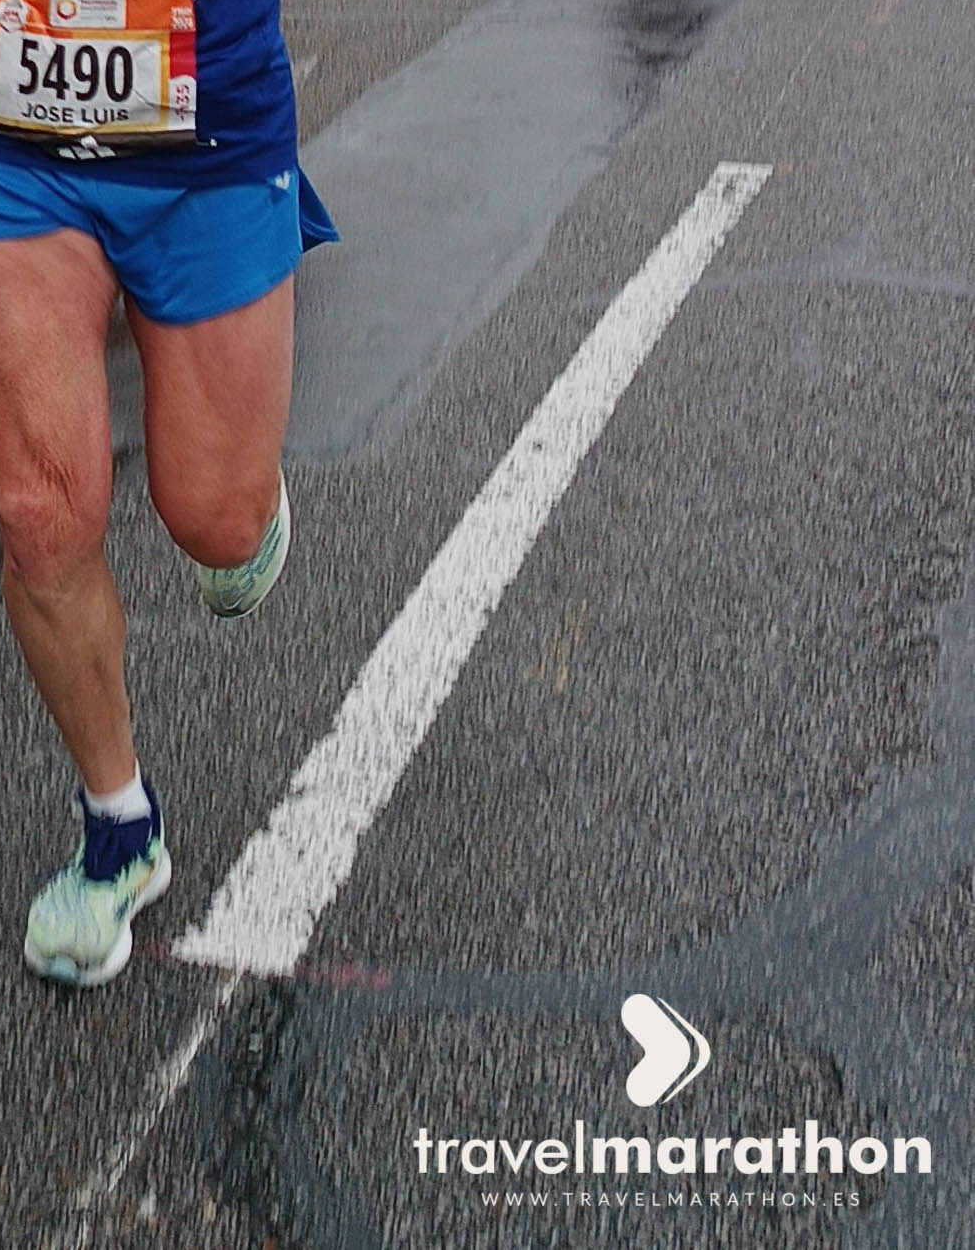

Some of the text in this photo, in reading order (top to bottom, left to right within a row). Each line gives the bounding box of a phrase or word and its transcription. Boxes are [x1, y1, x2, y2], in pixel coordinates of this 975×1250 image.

[17, 38, 134, 103] 5490
[21, 102, 130, 125] JOSE LUIS
